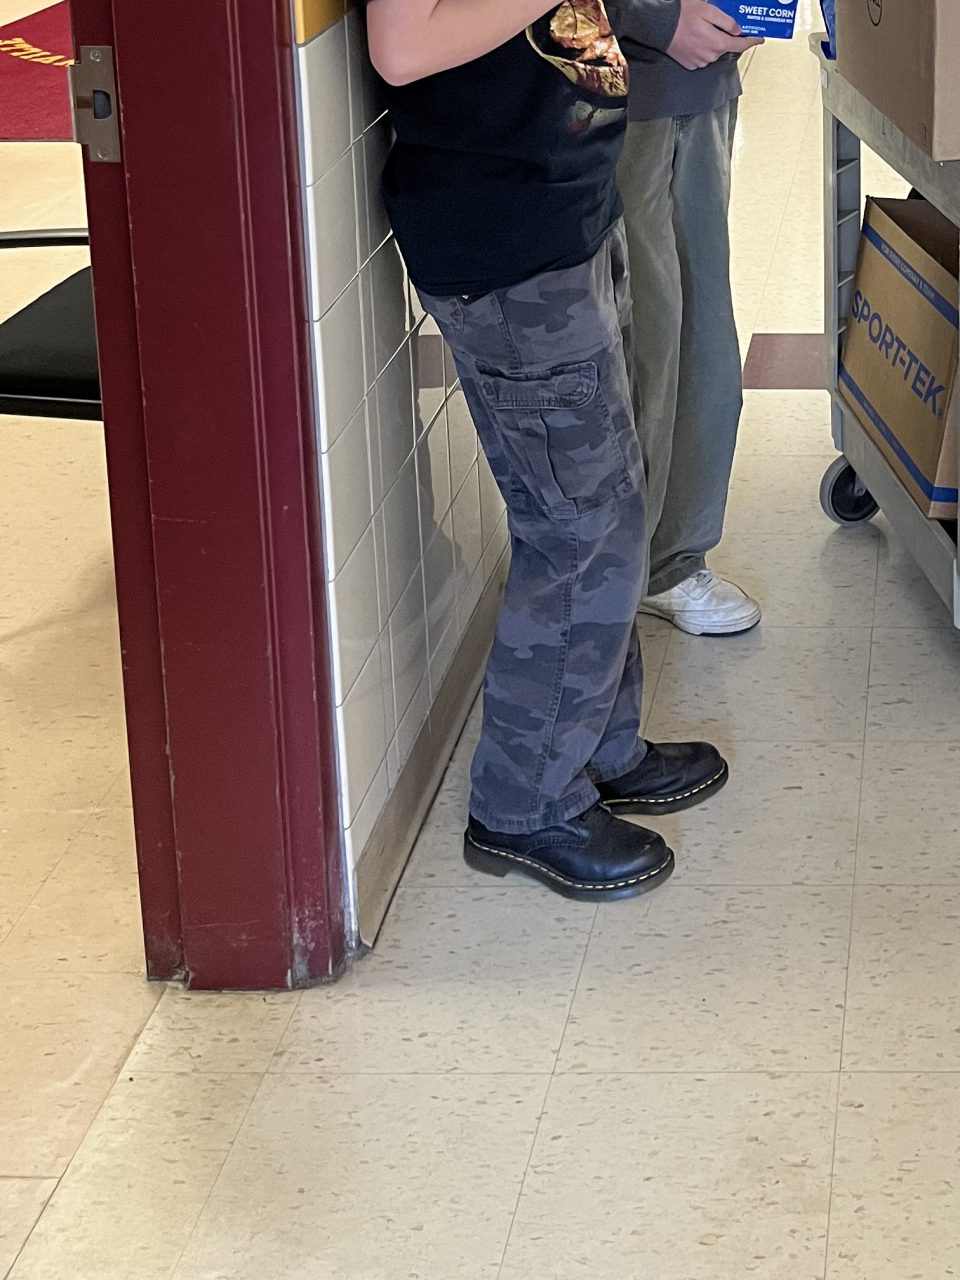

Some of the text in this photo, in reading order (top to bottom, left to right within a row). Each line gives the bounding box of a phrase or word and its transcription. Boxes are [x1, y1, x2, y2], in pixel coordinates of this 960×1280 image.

[739, 5, 794, 18] SWEET CORN
[852, 290, 946, 416] SPORT-TEK
